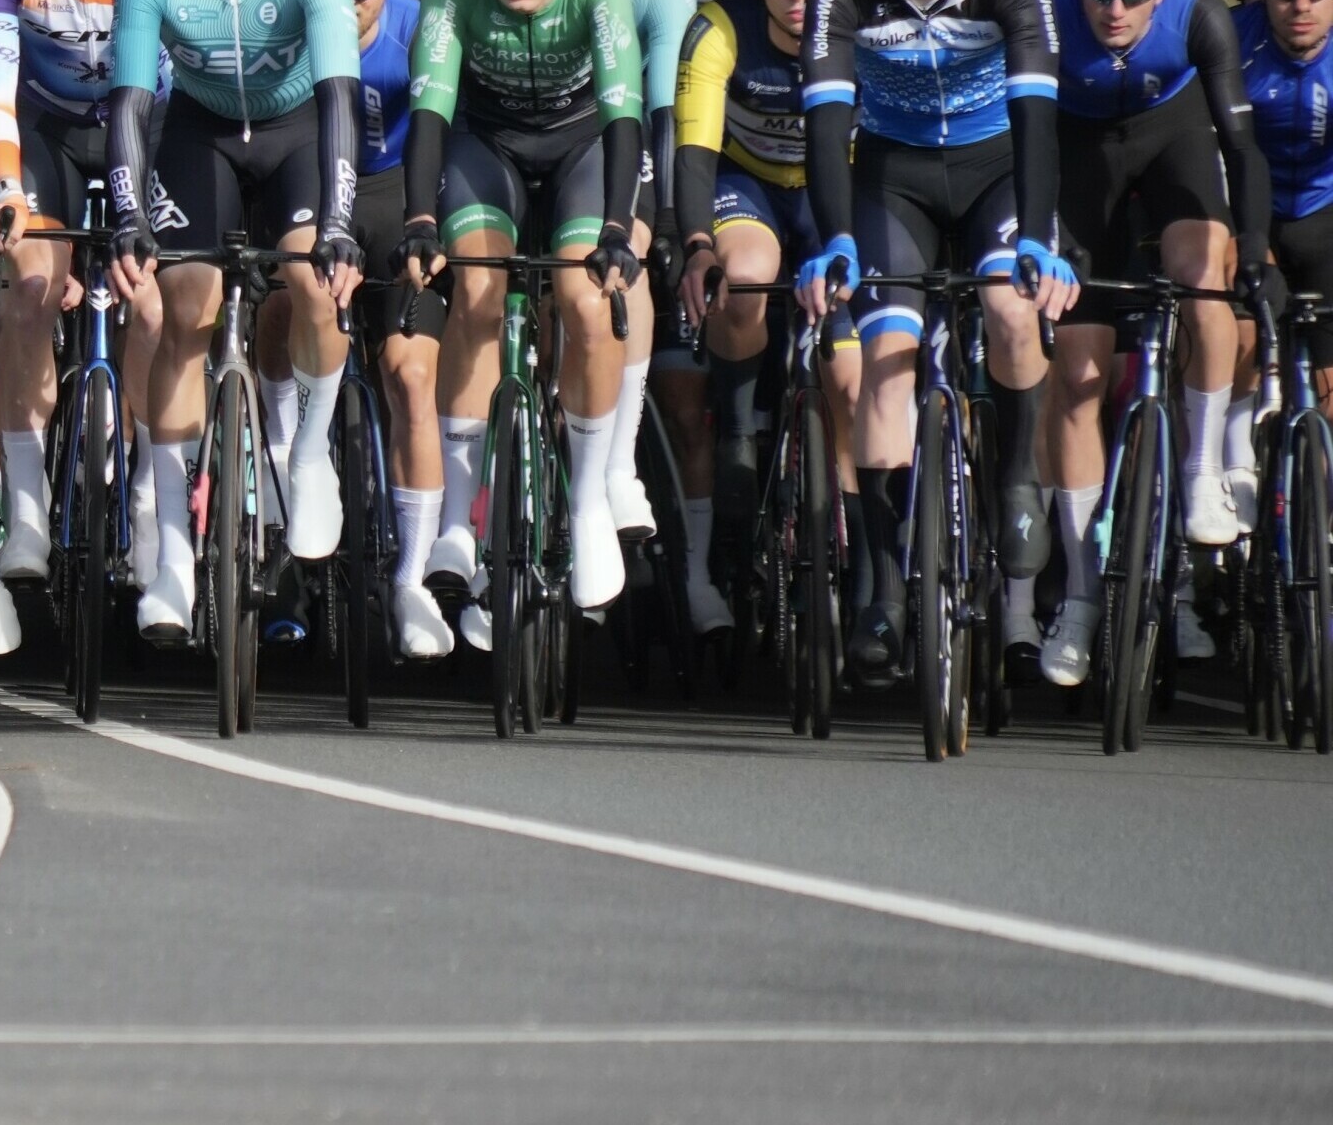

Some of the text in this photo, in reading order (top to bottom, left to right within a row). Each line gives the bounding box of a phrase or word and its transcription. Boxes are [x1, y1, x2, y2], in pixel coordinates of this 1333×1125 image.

[429, 0, 457, 64] Kingspan
[472, 42, 590, 64] PARKHOTEL
[593, 1, 616, 70] Kingspan
[171, 39, 303, 76] BEAT
[471, 47, 592, 76] Valkenbur
[364, 85, 387, 153] GIANT
[1310, 82, 1329, 146] GIANT
[109, 165, 138, 214] BEAT
[452, 213, 499, 231] DYNAMIC
